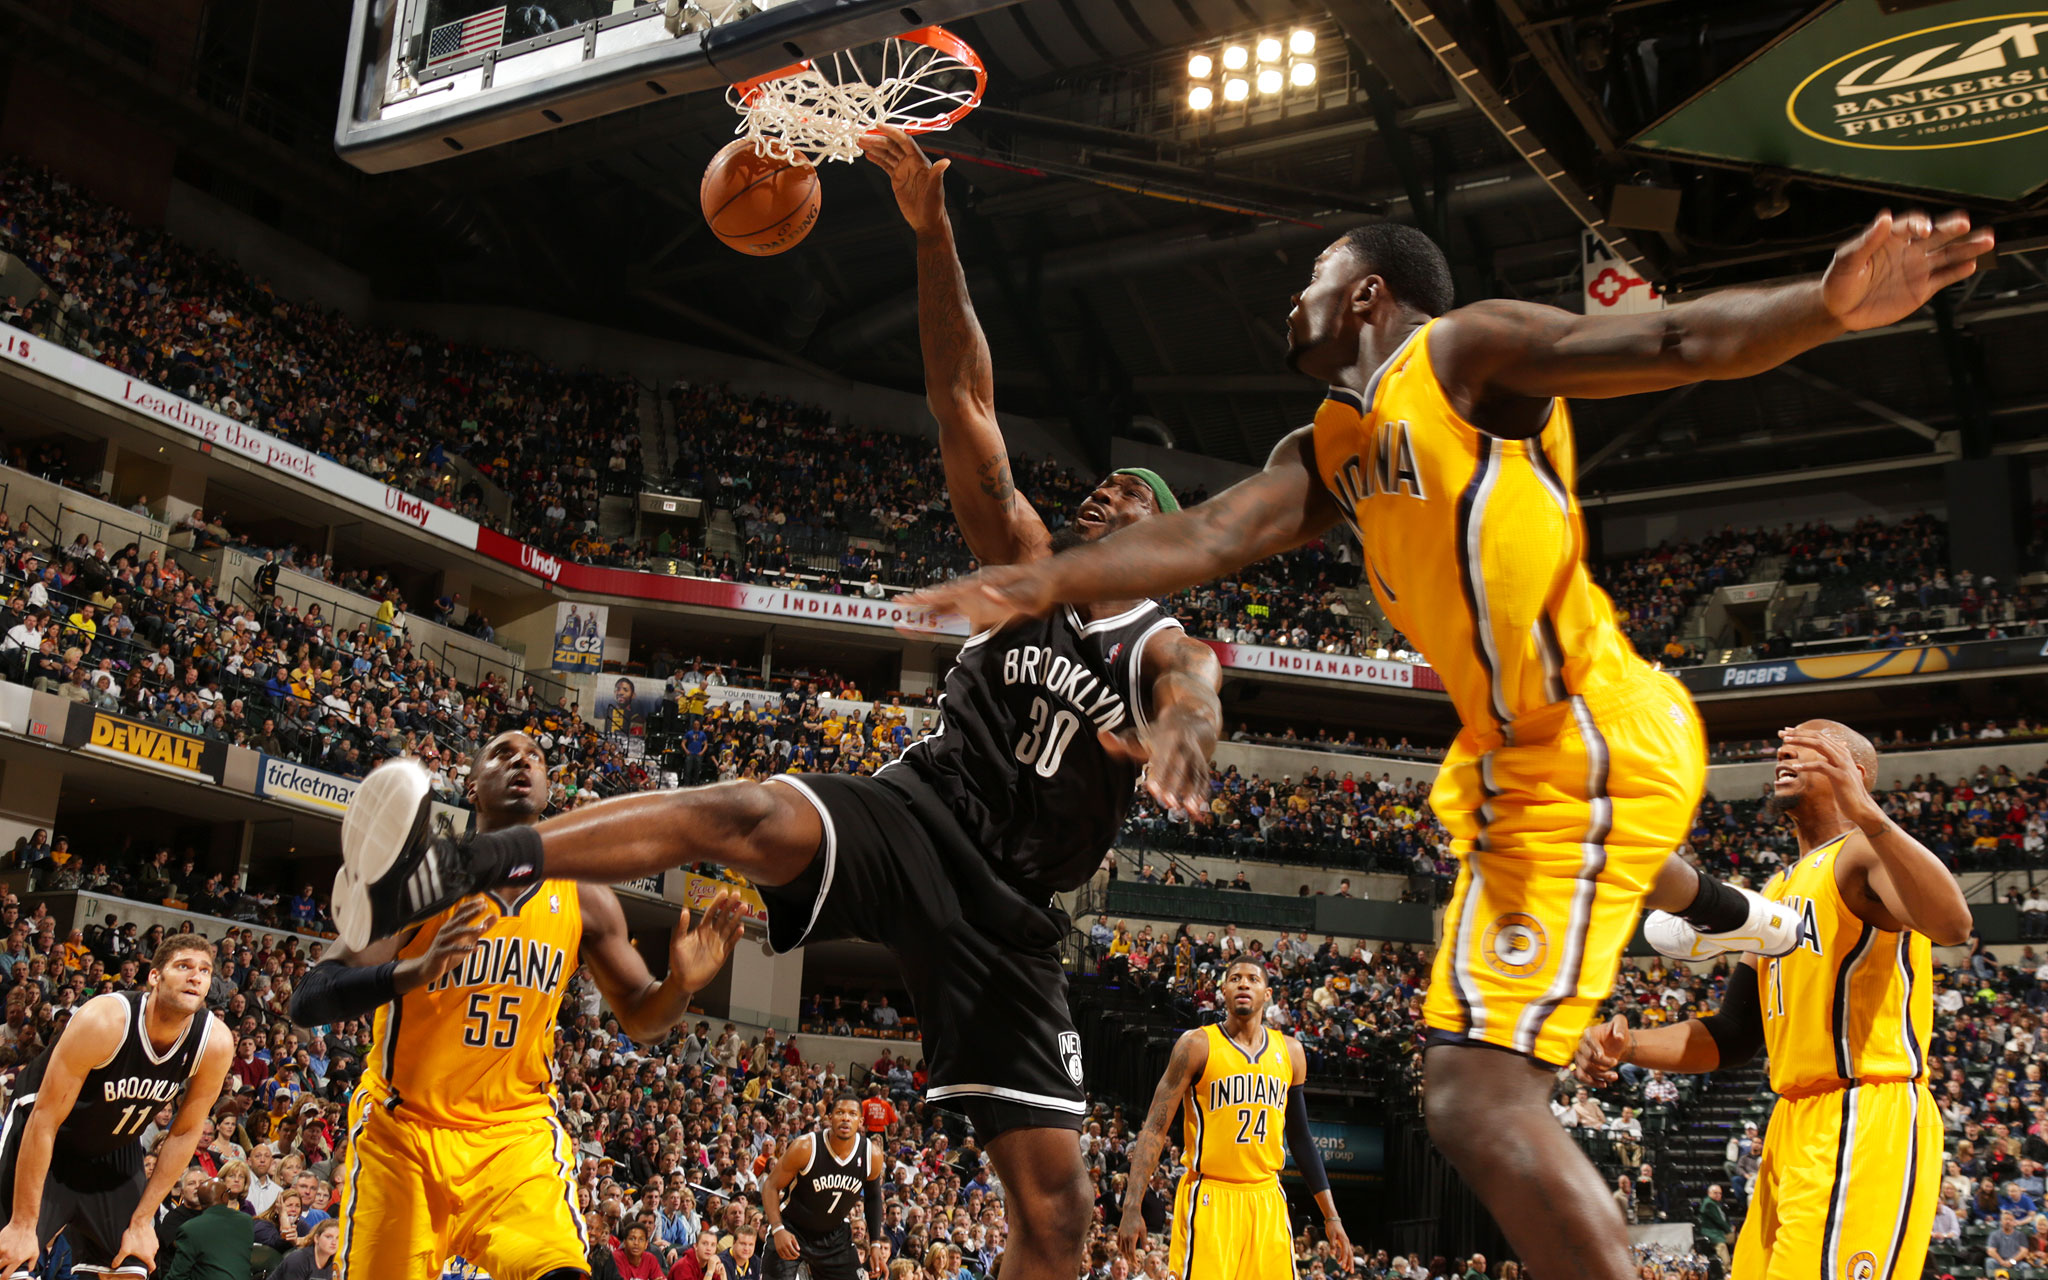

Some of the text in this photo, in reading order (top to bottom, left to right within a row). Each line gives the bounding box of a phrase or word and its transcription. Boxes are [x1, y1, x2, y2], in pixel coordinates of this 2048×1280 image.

[1833, 69, 2033, 117] BANKERS
[122, 378, 317, 478] Leading the pack
[384, 487, 431, 528] UIndy
[520, 544, 562, 582] UIndy
[758, 592, 776, 609] of
[554, 649, 601, 667] ZONE
[575, 636, 602, 653] G2
[1247, 651, 1263, 666] of
[1269, 651, 1410, 683] INDIANAPOLIS
[1723, 666, 1788, 687] Pacers
[723, 690, 739, 698] YOU
[740, 691, 758, 700] ARE
[759, 693, 767, 701] IN
[1003, 645, 1126, 733] BROOKLYN
[33, 722, 48, 737] EXIT
[1015, 695, 1080, 778] 30
[427, 936, 565, 998] NDIANA
[463, 993, 523, 1049] 55
[1209, 1072, 1288, 1112] INDIANA
[112, 1104, 153, 1135] 11
[1235, 1108, 1268, 1144] 24
[1324, 1150, 1355, 1163] group
[812, 1174, 863, 1195] BROOKLYN
[827, 1191, 843, 1214] 7
